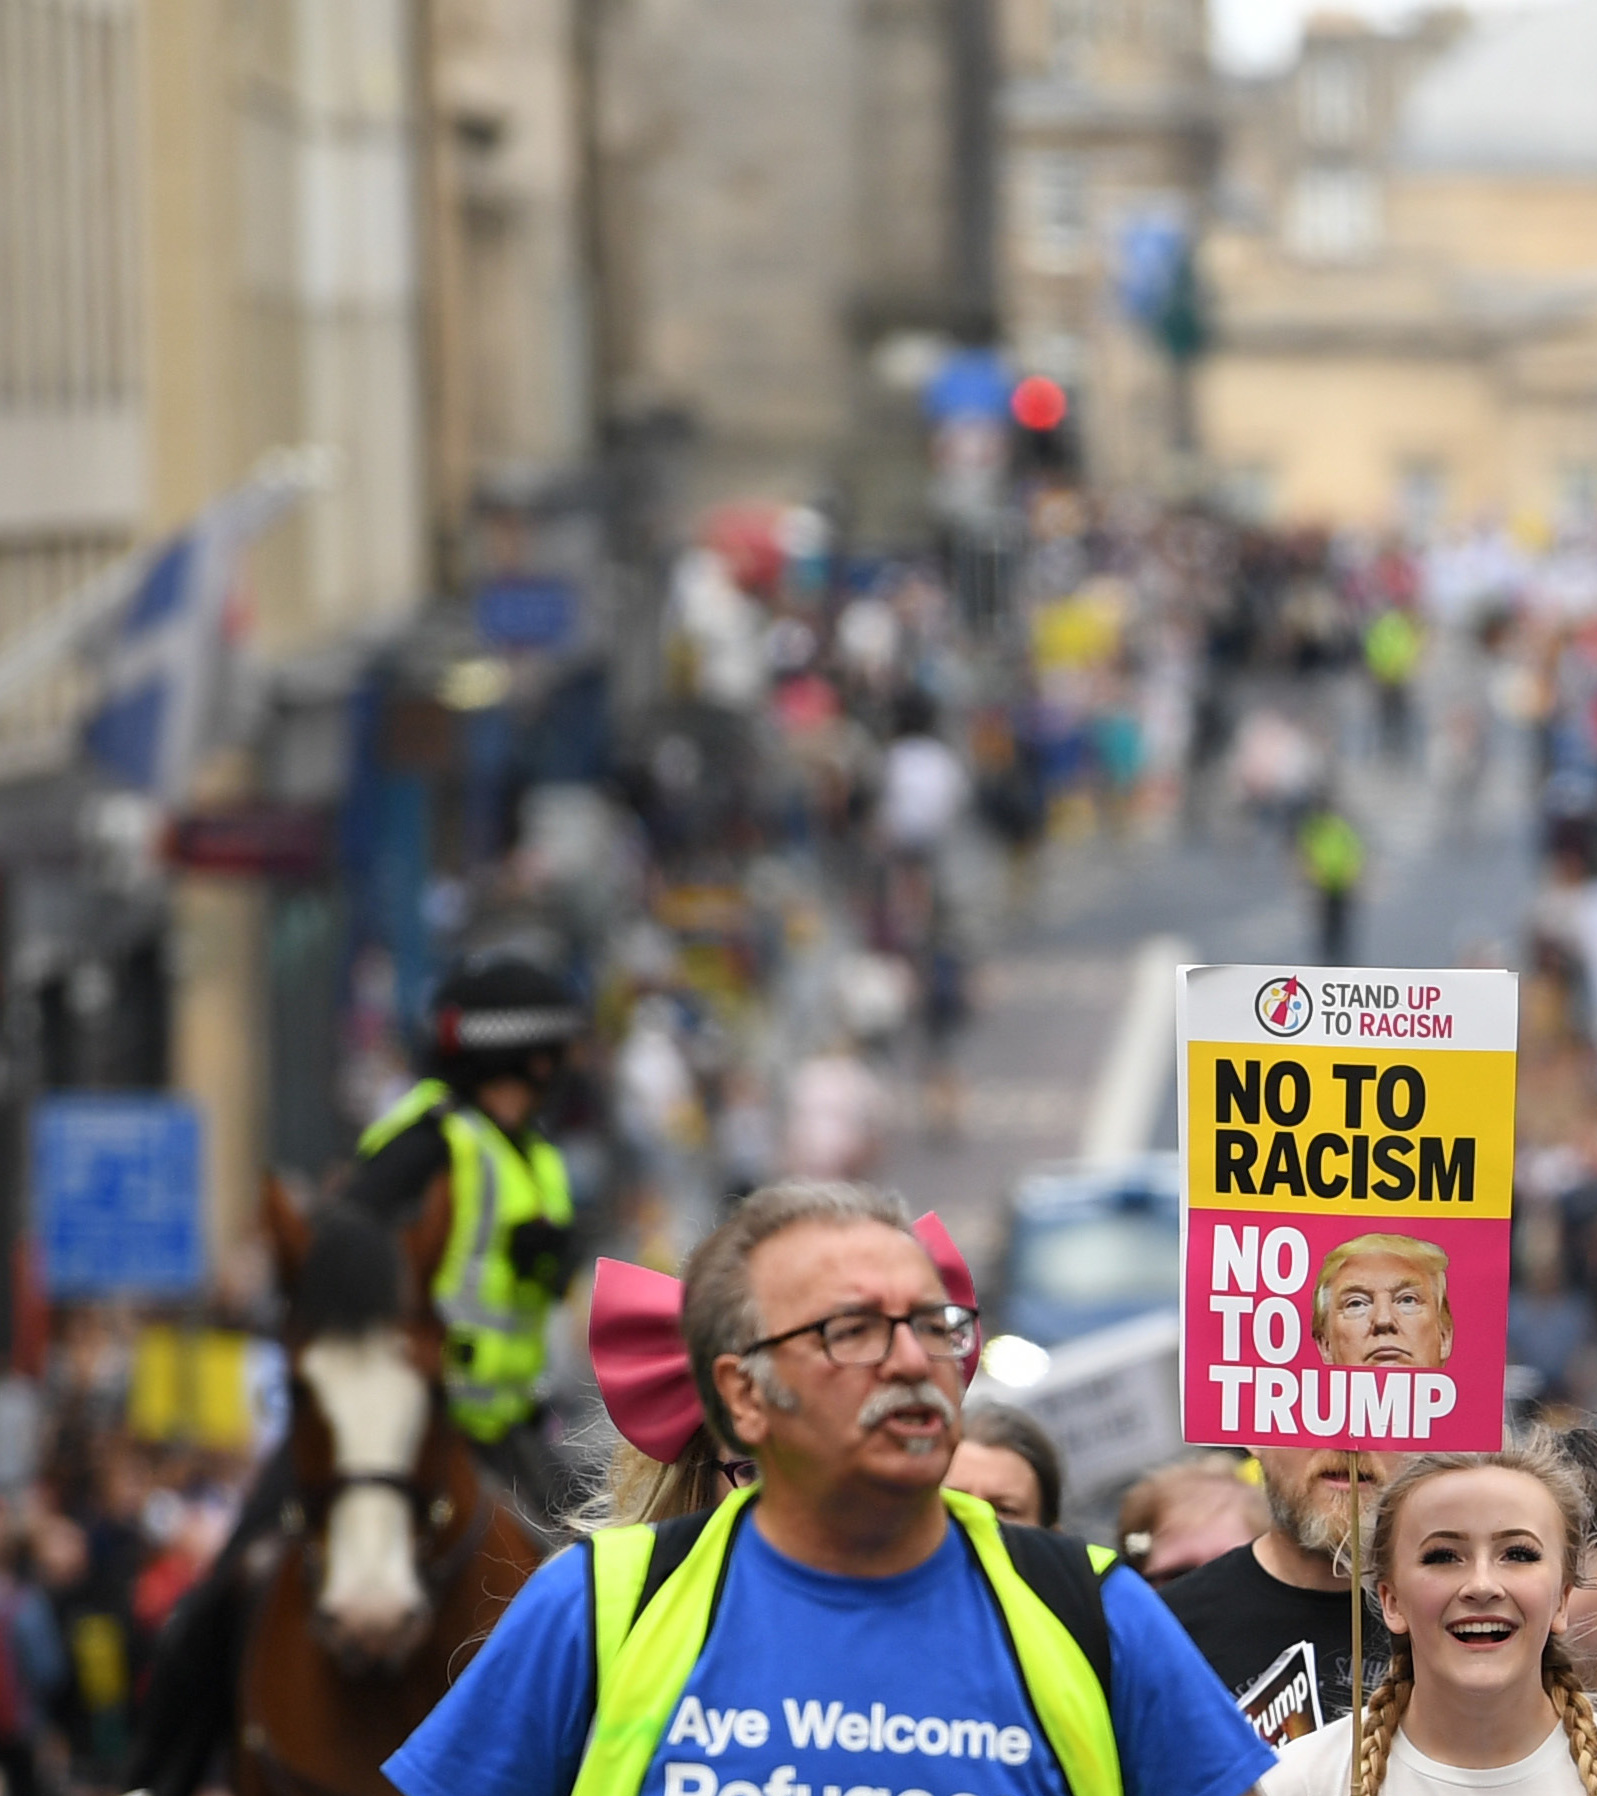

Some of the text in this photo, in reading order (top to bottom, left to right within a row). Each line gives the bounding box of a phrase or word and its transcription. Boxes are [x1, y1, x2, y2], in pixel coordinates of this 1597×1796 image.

[1321, 983, 1441, 1011] STAND UP
[1321, 1011, 1453, 1039] TO RACISM
[1215, 1058, 1427, 1132] NO TO
[1215, 1129, 1476, 1202] RACISM
[1212, 1224, 1308, 1294] NO
[1210, 1296, 1300, 1365] TO
[1209, 1366, 1457, 1440] TRUMP
[668, 1695, 1032, 1767] Aye Welcome
